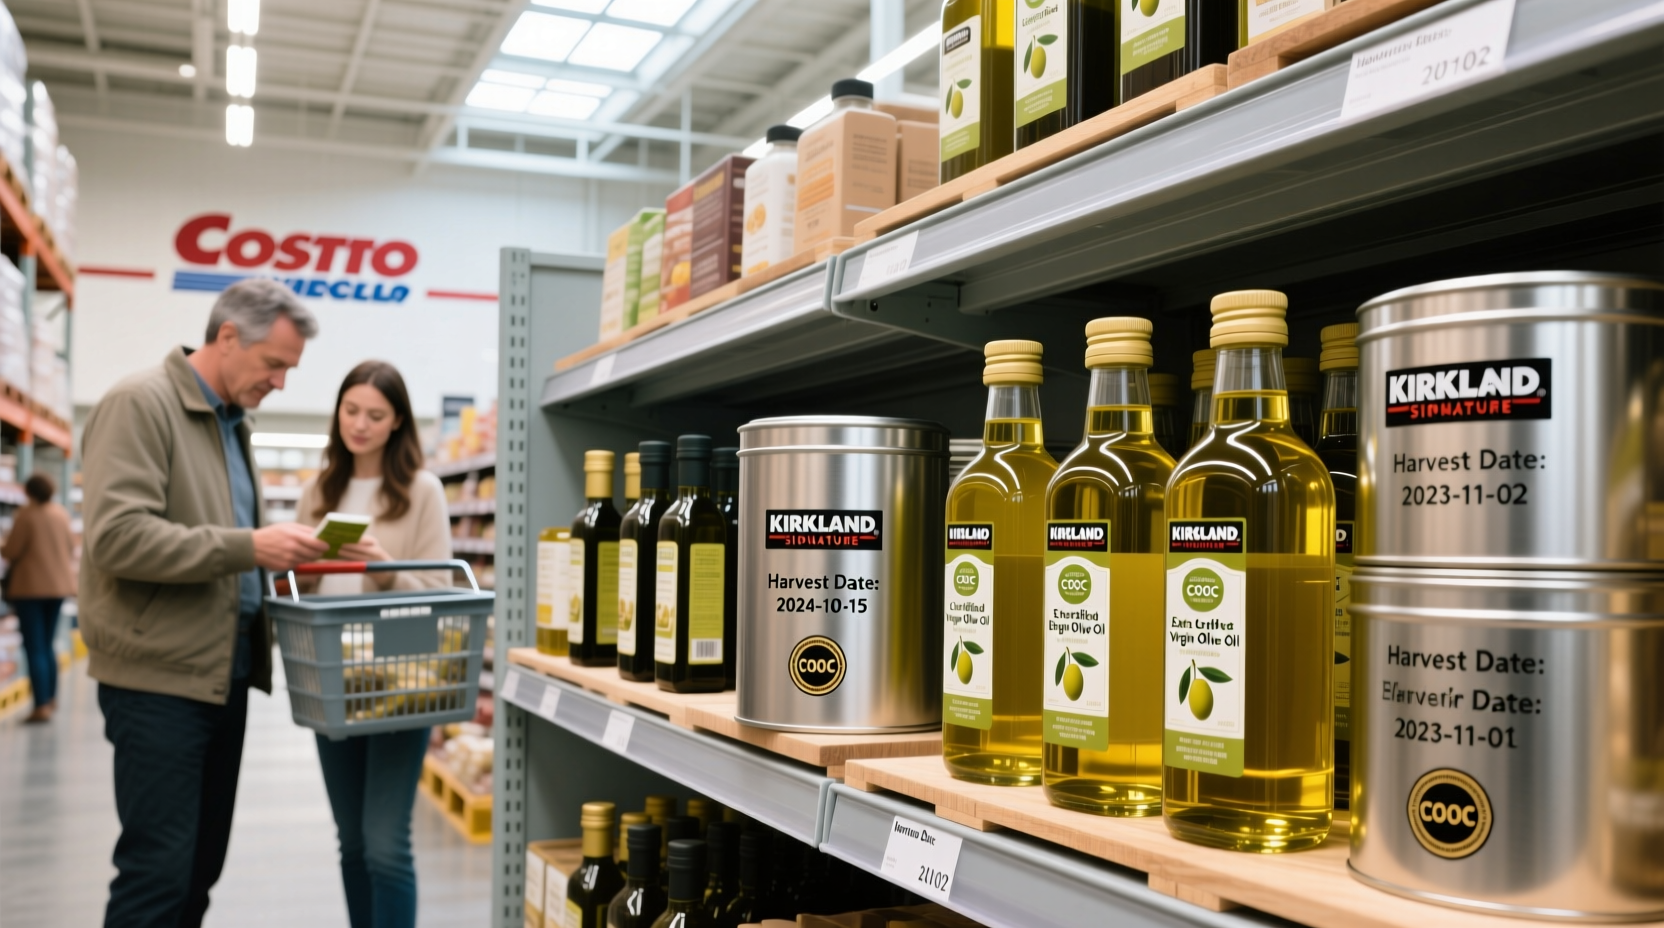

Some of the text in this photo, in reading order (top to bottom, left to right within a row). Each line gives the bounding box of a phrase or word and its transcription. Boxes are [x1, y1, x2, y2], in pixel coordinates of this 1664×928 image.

[1389, 366, 1541, 404] KIRKLAND
[1394, 449, 1546, 473] Harvest Date:
[1402, 483, 1528, 506] 2023-11-02
[769, 514, 876, 533] KIRKLAND
[768, 573, 880, 590] Harvest Date:
[1186, 585, 1220, 598] COOC
[776, 597, 868, 613] 2024-10-15
[798, 658, 836, 673] COOC
[1388, 645, 1545, 675] Harvest Date:
[1472, 689, 1542, 715] Date:
[1394, 717, 1518, 749] 2023-11-01
[1419, 800, 1476, 827] COOC
